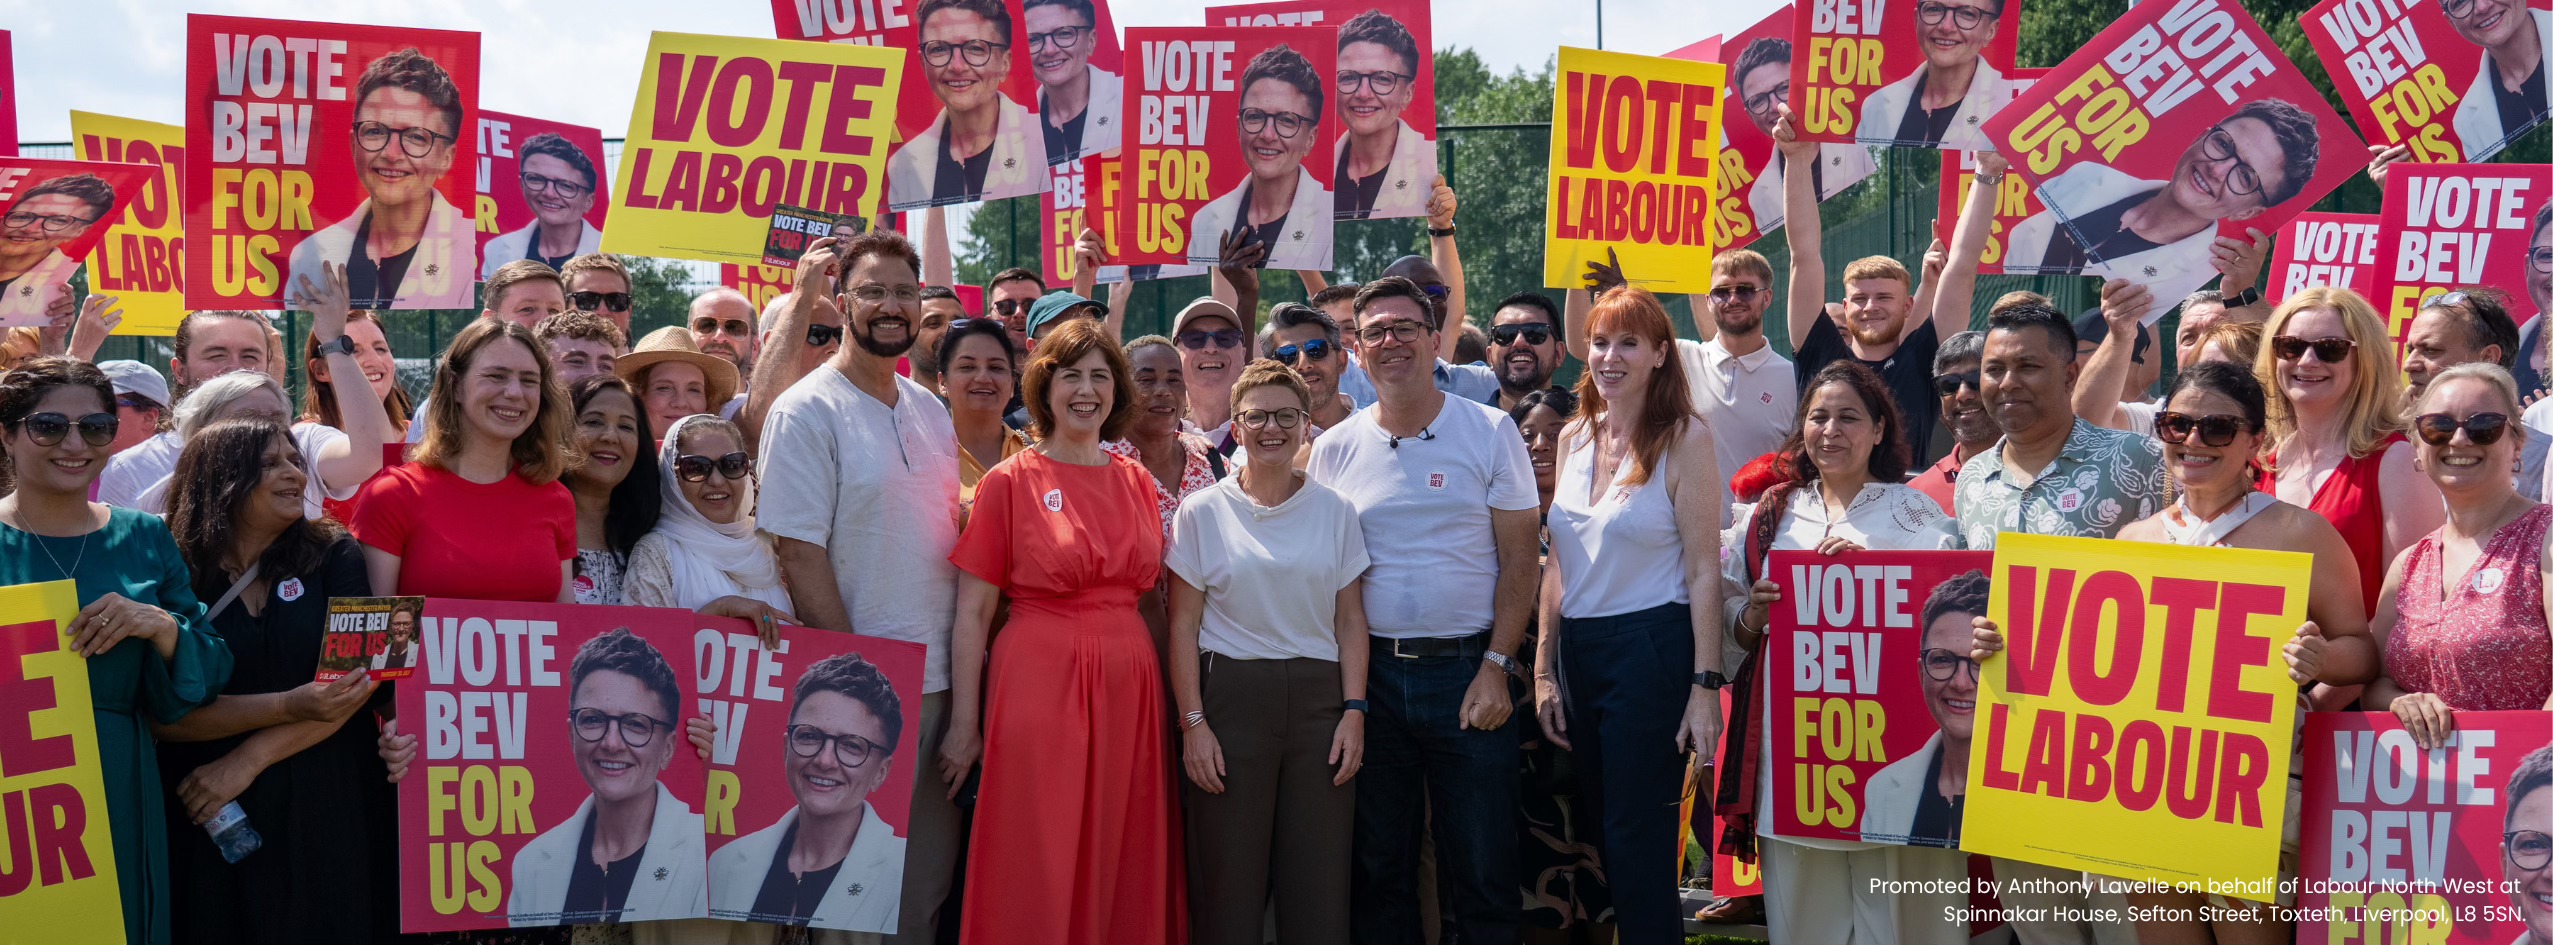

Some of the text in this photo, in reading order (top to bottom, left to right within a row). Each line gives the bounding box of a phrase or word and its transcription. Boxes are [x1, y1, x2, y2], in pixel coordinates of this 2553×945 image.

[1811, 0, 1886, 35] BEV
[213, 32, 348, 101] VOTE
[1141, 40, 1236, 92] VOTE
[1808, 37, 1884, 86] FOR
[2104, 23, 2205, 118] BEV
[2157, 0, 2276, 105] VOTE
[2344, 16, 2427, 101] BEV
[212, 101, 313, 165] BEV
[651, 52, 887, 157] VOTE
[1140, 96, 1210, 146] BEV
[1566, 71, 1715, 178] VOTE
[1804, 87, 1856, 135] US
[2054, 62, 2150, 164] FOR
[2369, 63, 2459, 145] FOR
[2008, 102, 2082, 175] US
[212, 168, 315, 231] FOR
[624, 147, 869, 219] LABOUR
[1138, 149, 1210, 201] FOR
[2407, 177, 2531, 230] VOTE
[769, 229, 803, 251] FOR
[774, 214, 831, 237] VOTE BEV
[1137, 202, 1186, 255] US
[1556, 176, 1707, 247] LABOUR
[1713, 196, 1752, 248] US
[2293, 221, 2380, 265] VOTE
[212, 234, 281, 297] US
[770, 259, 791, 267] Labour
[2394, 230, 2492, 284] BEV
[1429, 479, 1443, 487] BEV
[2062, 499, 2076, 508] BEV
[283, 580, 299, 590] VOTE
[284, 586, 299, 597] BEV
[1792, 565, 1913, 628] VOTE
[325, 632, 388, 658] FOR US
[329, 612, 390, 632] VOTE BEV
[421, 617, 561, 687] VOTE
[2006, 565, 2286, 724] VOTE
[694, 628, 790, 702] OTE
[1793, 631, 1882, 695] BEV
[425, 691, 528, 761] BEV
[1794, 697, 1887, 763] FOR
[1795, 764, 1857, 829] US
[1982, 703, 2270, 829] LABOUR
[2333, 729, 2496, 806] VOTE
[427, 765, 537, 837] FOR
[429, 841, 503, 916] US
[2330, 809, 2452, 888] BEV
[2327, 890, 2454, 945] FOR
